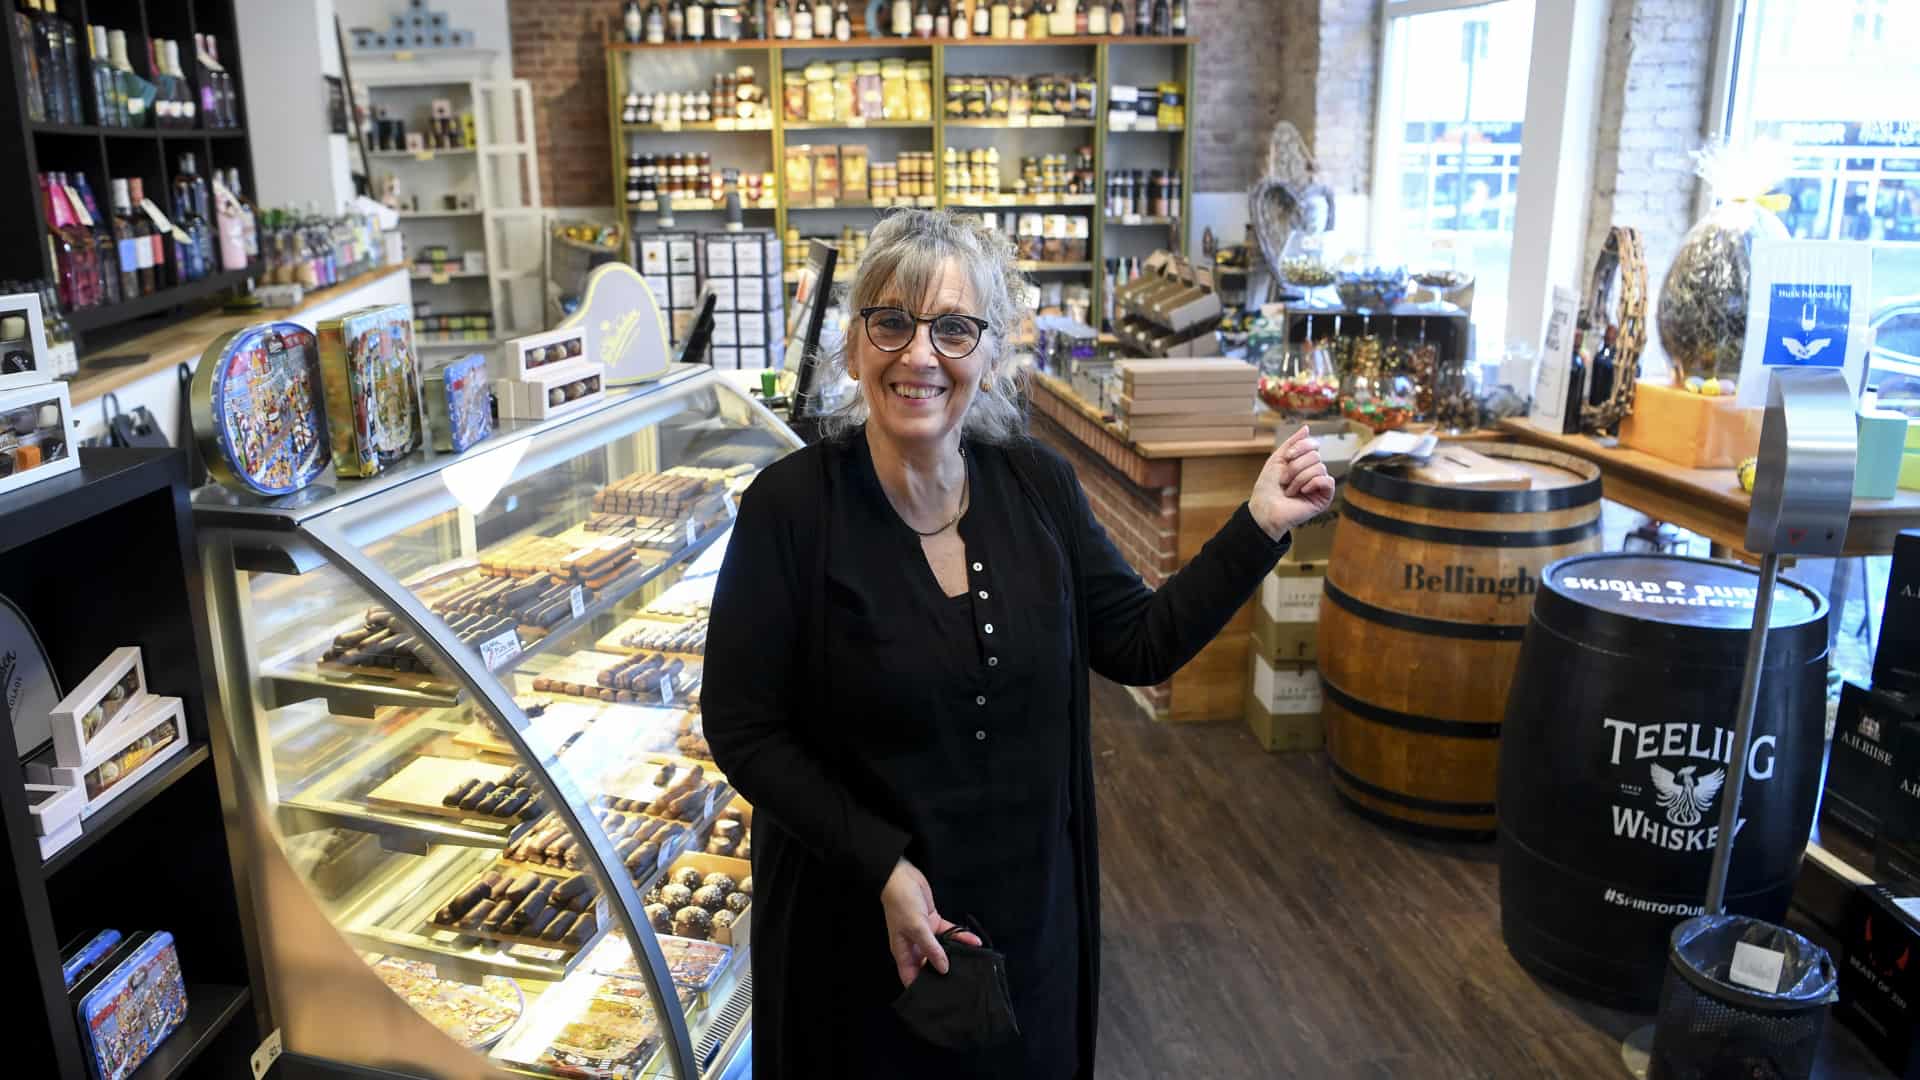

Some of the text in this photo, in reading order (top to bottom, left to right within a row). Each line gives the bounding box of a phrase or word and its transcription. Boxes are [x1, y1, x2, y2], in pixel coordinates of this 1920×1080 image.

[1403, 563, 1536, 604] Bellingh
[1563, 577, 1661, 594] SKJOLD
[1617, 590, 1754, 608] Randers
